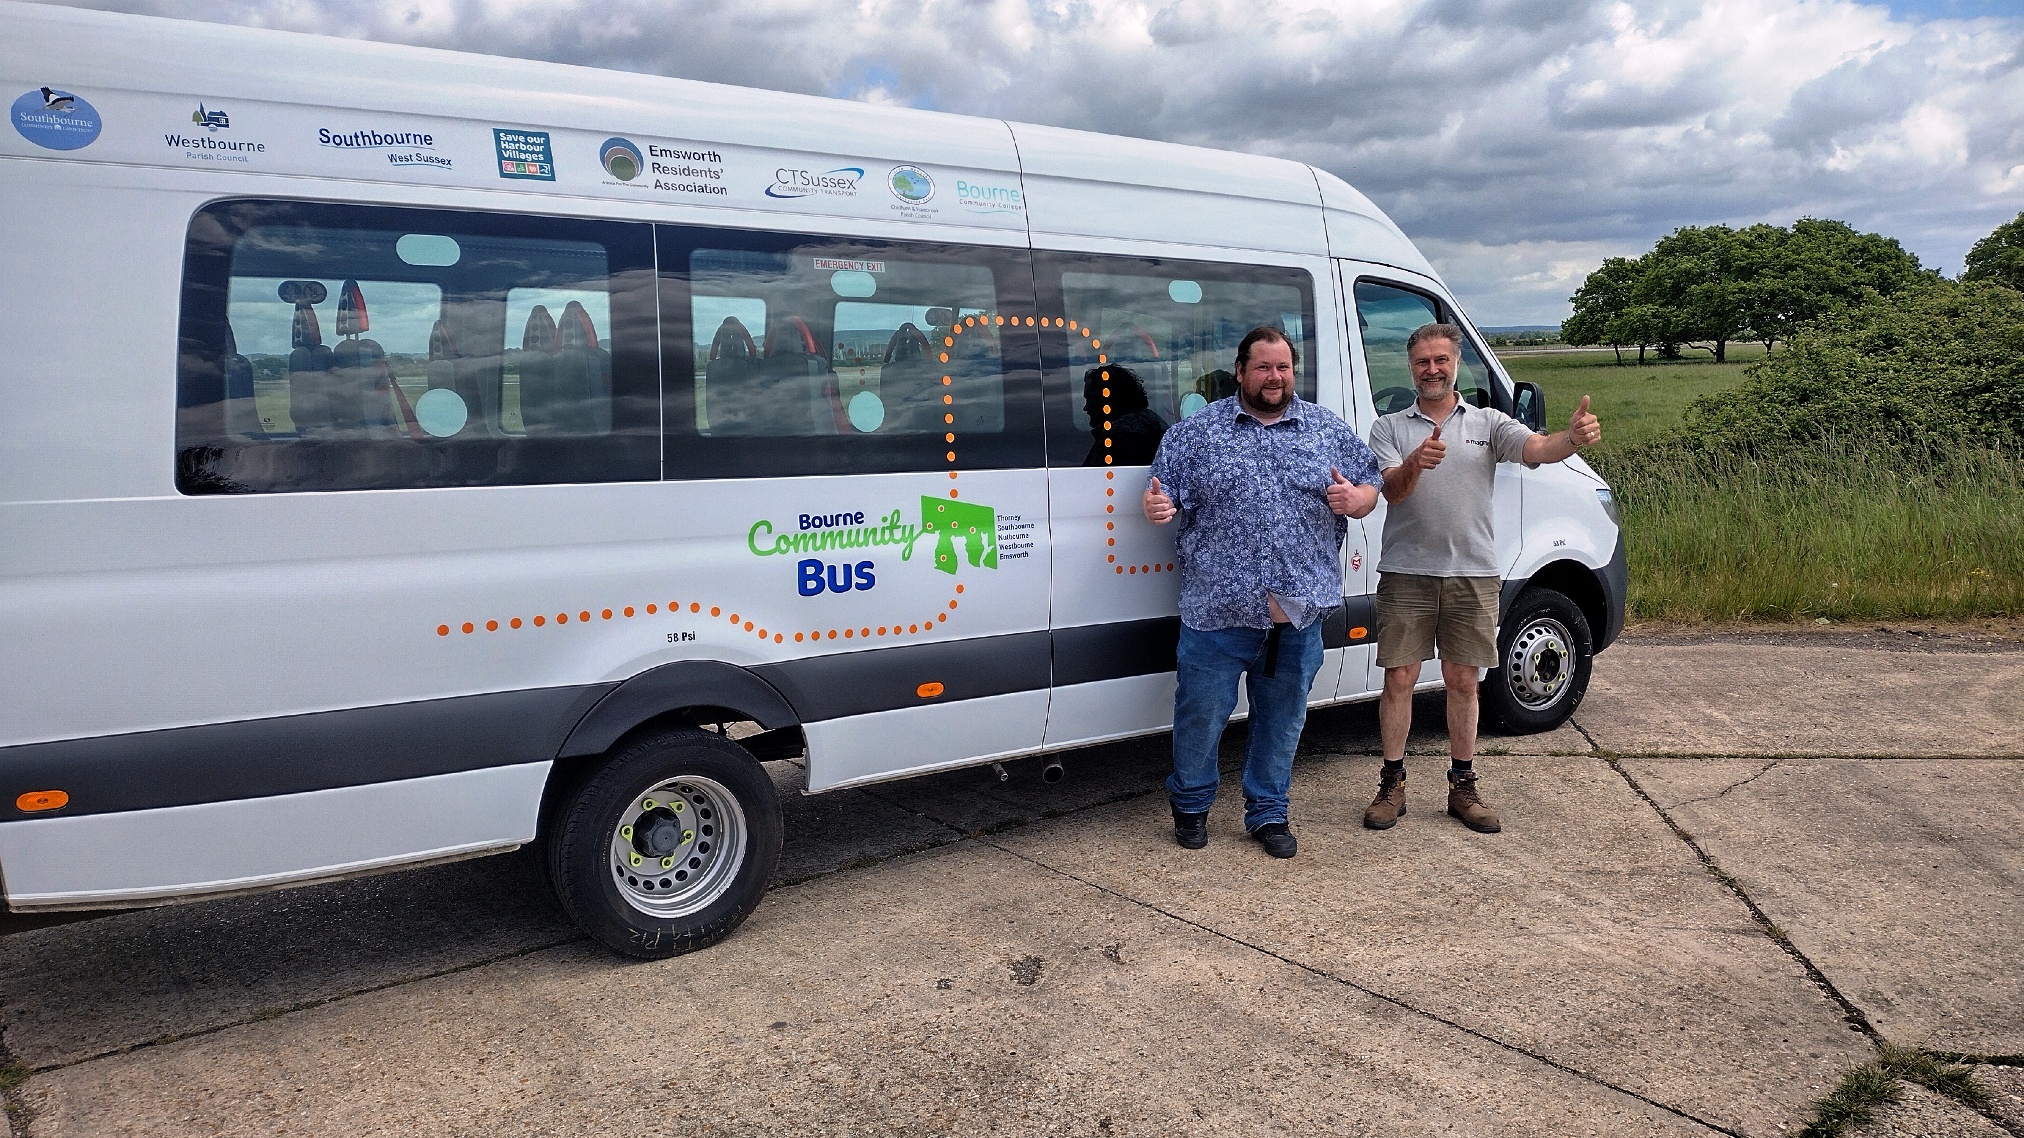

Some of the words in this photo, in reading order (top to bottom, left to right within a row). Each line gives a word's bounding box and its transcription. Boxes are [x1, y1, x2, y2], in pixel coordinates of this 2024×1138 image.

[20, 111, 93, 127] Southbourne
[164, 134, 265, 153] Westbourne
[318, 128, 433, 147] Southbourne
[499, 132, 525, 142] Save
[526, 136, 545, 144] our
[500, 141, 545, 152] Harbour
[186, 151, 214, 161] Parish
[216, 153, 249, 163] Council
[387, 153, 414, 163] West
[415, 152, 452, 166] Sussex
[501, 149, 545, 162] Villages
[648, 144, 722, 163] Emsworth
[651, 162, 724, 180] Residents'
[775, 168, 857, 190] CTSussex
[654, 178, 728, 196] Association
[778, 185, 818, 194] COMMUNITY
[820, 188, 858, 197] TRANSPORT
[956, 180, 1020, 203] Bourne
[959, 199, 996, 209] Community
[998, 202, 1022, 211] College
[815, 259, 864, 270] EMERGENCY
[866, 262, 884, 271] EXIT
[798, 511, 865, 531] Bourne
[997, 514, 1022, 522] Thorney
[997, 523, 1035, 532] Southbourne
[748, 508, 916, 562] Community
[999, 542, 1034, 550] Westbourne
[1000, 550, 1029, 560] Emsworth
[667, 632, 679, 643] 58
[681, 630, 696, 642] Psi
